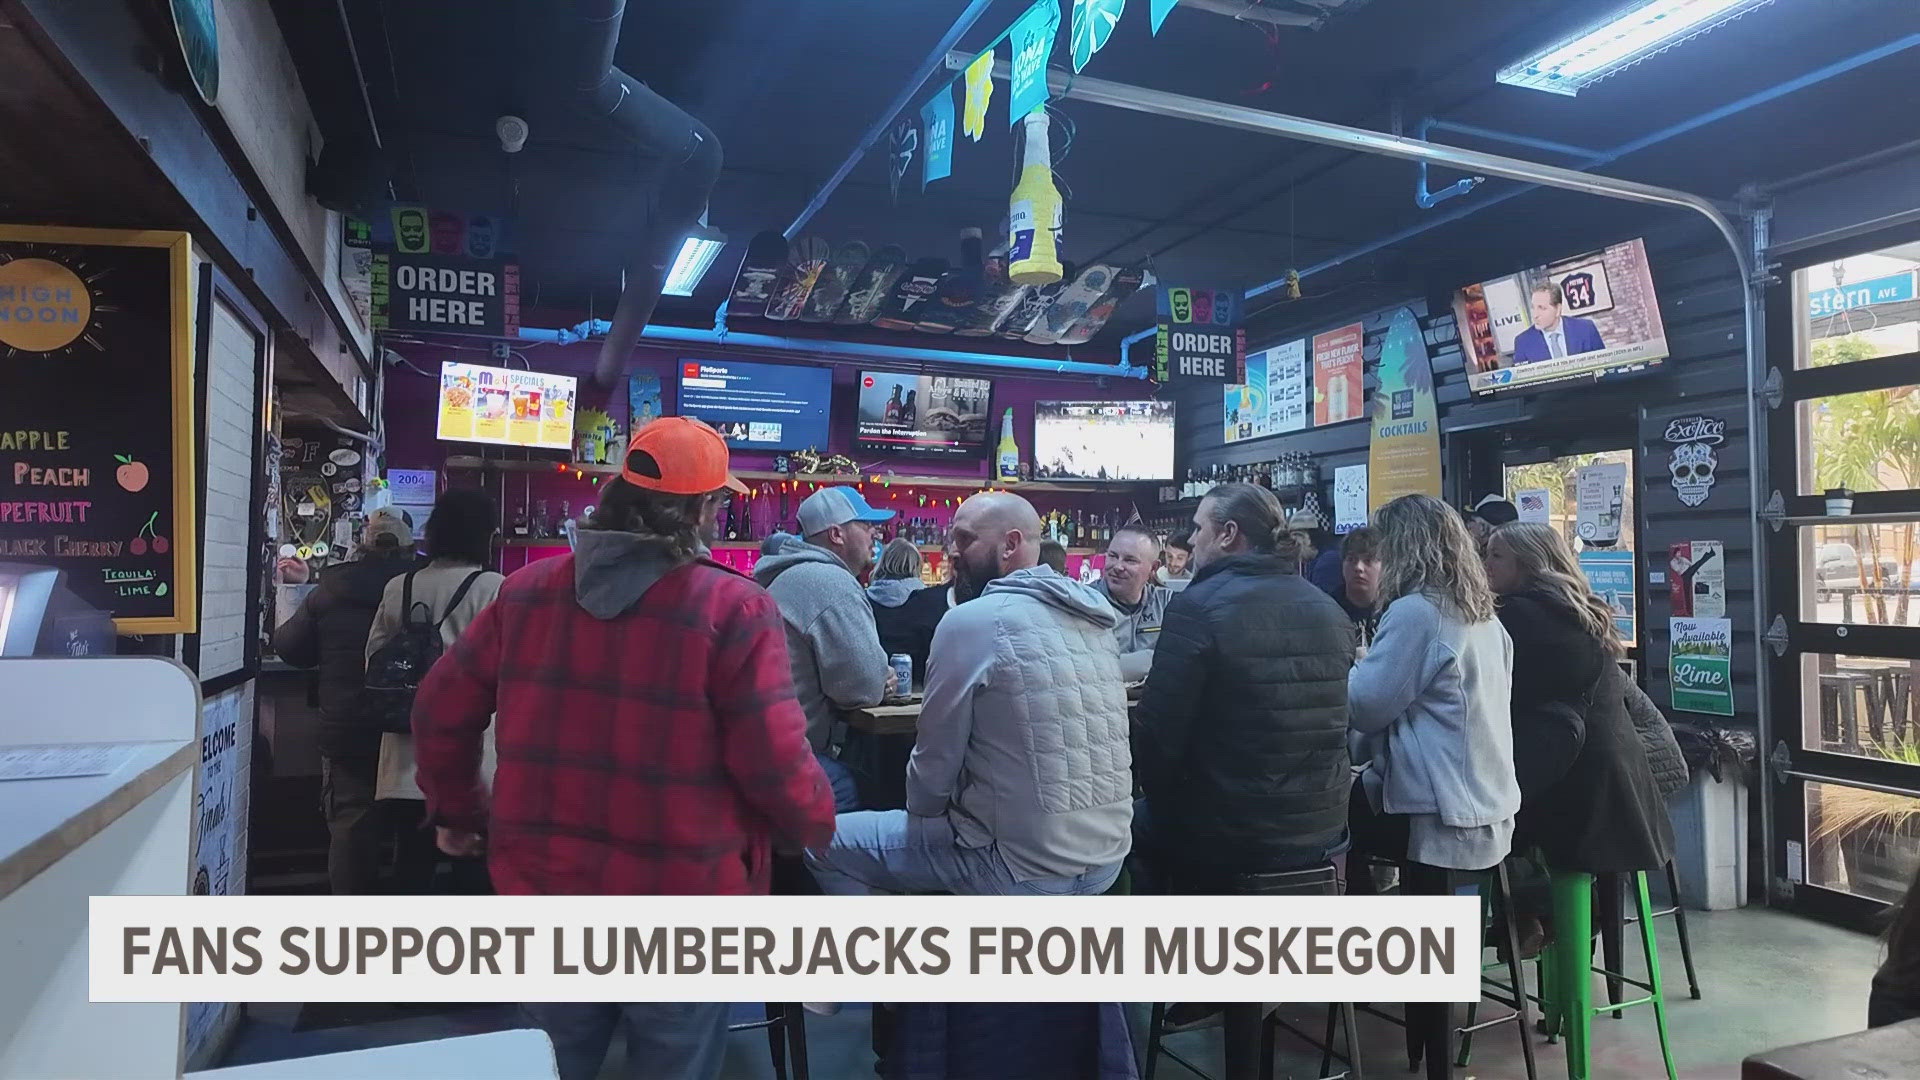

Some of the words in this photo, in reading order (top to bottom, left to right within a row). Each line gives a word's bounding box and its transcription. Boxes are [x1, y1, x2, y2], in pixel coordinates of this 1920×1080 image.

[397, 265, 496, 296] ORDER
[0, 286, 72, 303] HIGH
[1570, 286, 1590, 307] 34
[1810, 287, 1871, 315] stern
[1878, 287, 1898, 299] AVE
[409, 297, 485, 325] HERE
[1494, 314, 1522, 327] LIVE
[1172, 332, 1232, 354] ORDER
[1180, 356, 1226, 377] HERE
[510, 373, 545, 387] SPECIALS
[859, 427, 881, 435] Pardon
[881, 427, 892, 435] the
[893, 428, 927, 437] Interruption
[1379, 420, 1428, 438] COCKTAILS
[14, 462, 90, 486] PEACH
[398, 475, 426, 484] 2004
[0, 539, 47, 557] LACK
[55, 534, 124, 557] CHERRY
[102, 569, 157, 580] TEQUILA:
[119, 586, 151, 596] LIME
[1142, 613, 1154, 621] M
[1674, 622, 1697, 632] Now
[1678, 631, 1726, 643] Available
[1673, 663, 1723, 687] Lime
[202, 722, 236, 763] ELCOME
[207, 765, 213, 780] TO
[213, 760, 221, 777] THE
